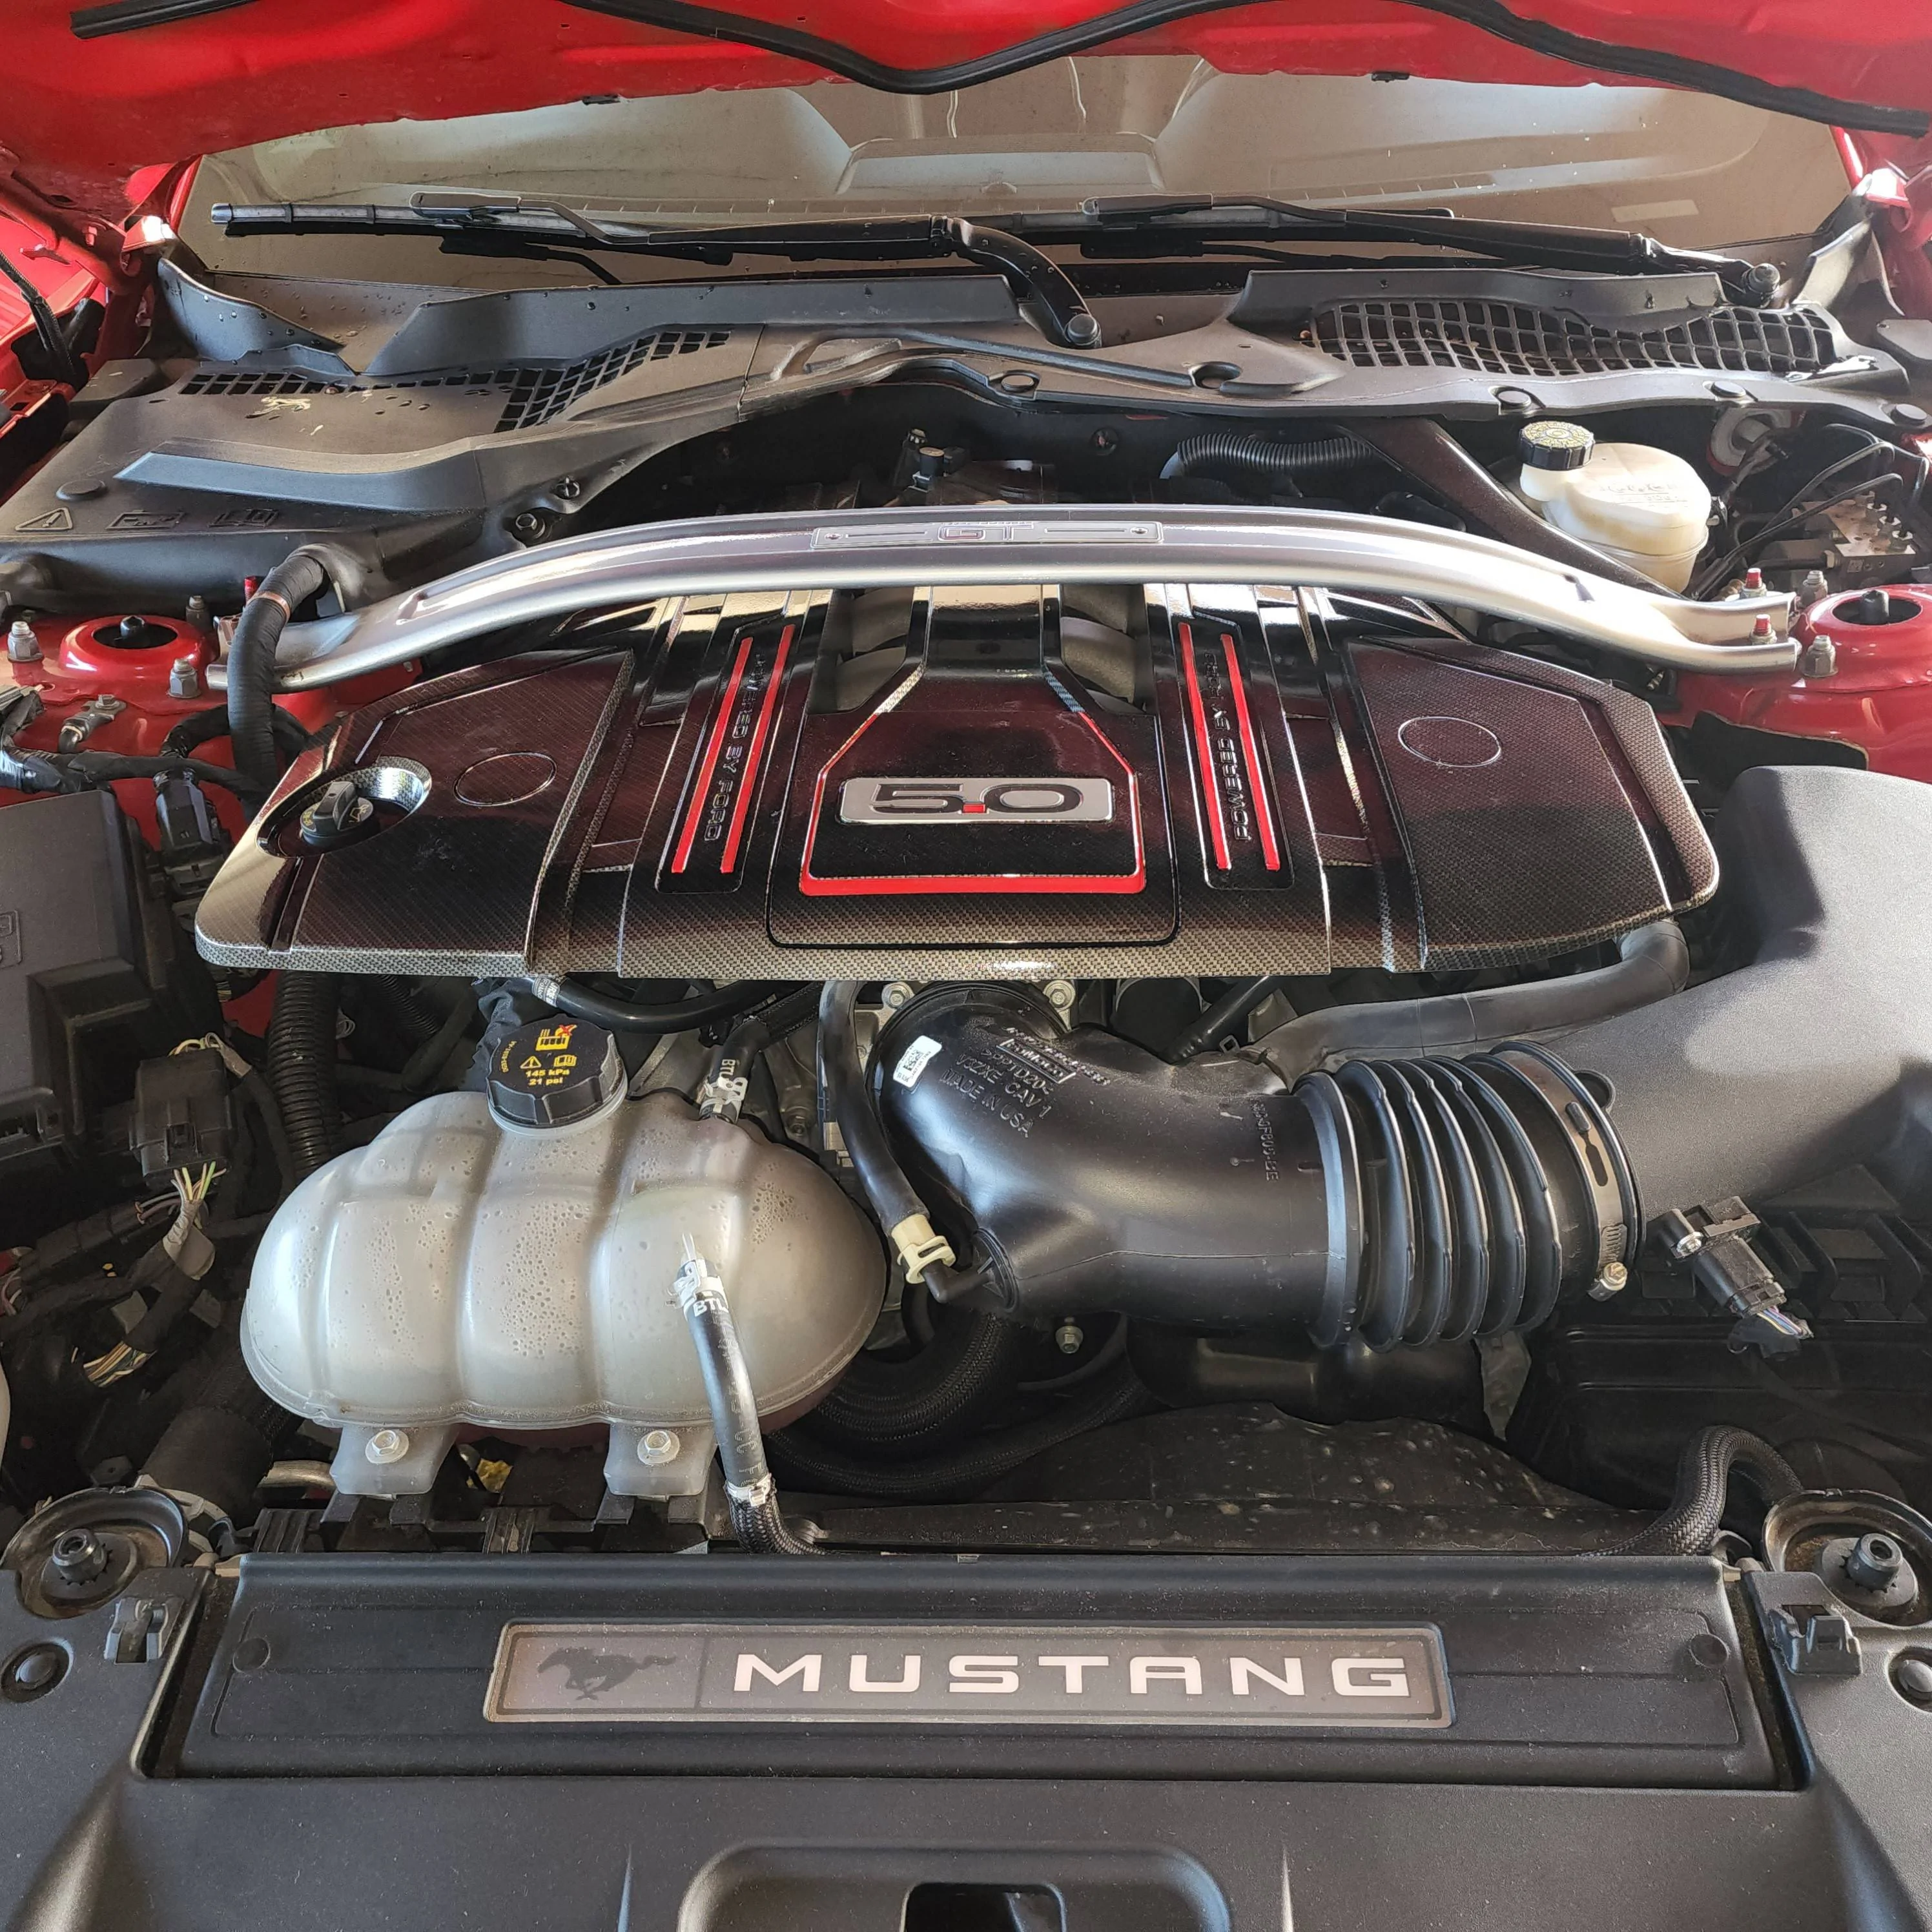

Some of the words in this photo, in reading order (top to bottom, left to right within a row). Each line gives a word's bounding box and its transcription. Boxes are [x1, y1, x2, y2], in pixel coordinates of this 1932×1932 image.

[938, 524, 1034, 541] GT
[722, 745, 743, 773] BY
[870, 783, 1085, 814] 5.0
[1218, 737, 1251, 840] POWERED
[704, 779, 734, 841] FORD
[526, 1069, 546, 1078] 145
[940, 1068, 984, 1100] MADE
[981, 1094, 1001, 1111] IN
[1000, 1104, 1034, 1138] USA
[1005, 1082, 1042, 1108] CAV
[734, 1653, 1411, 1696] MUSTANG
